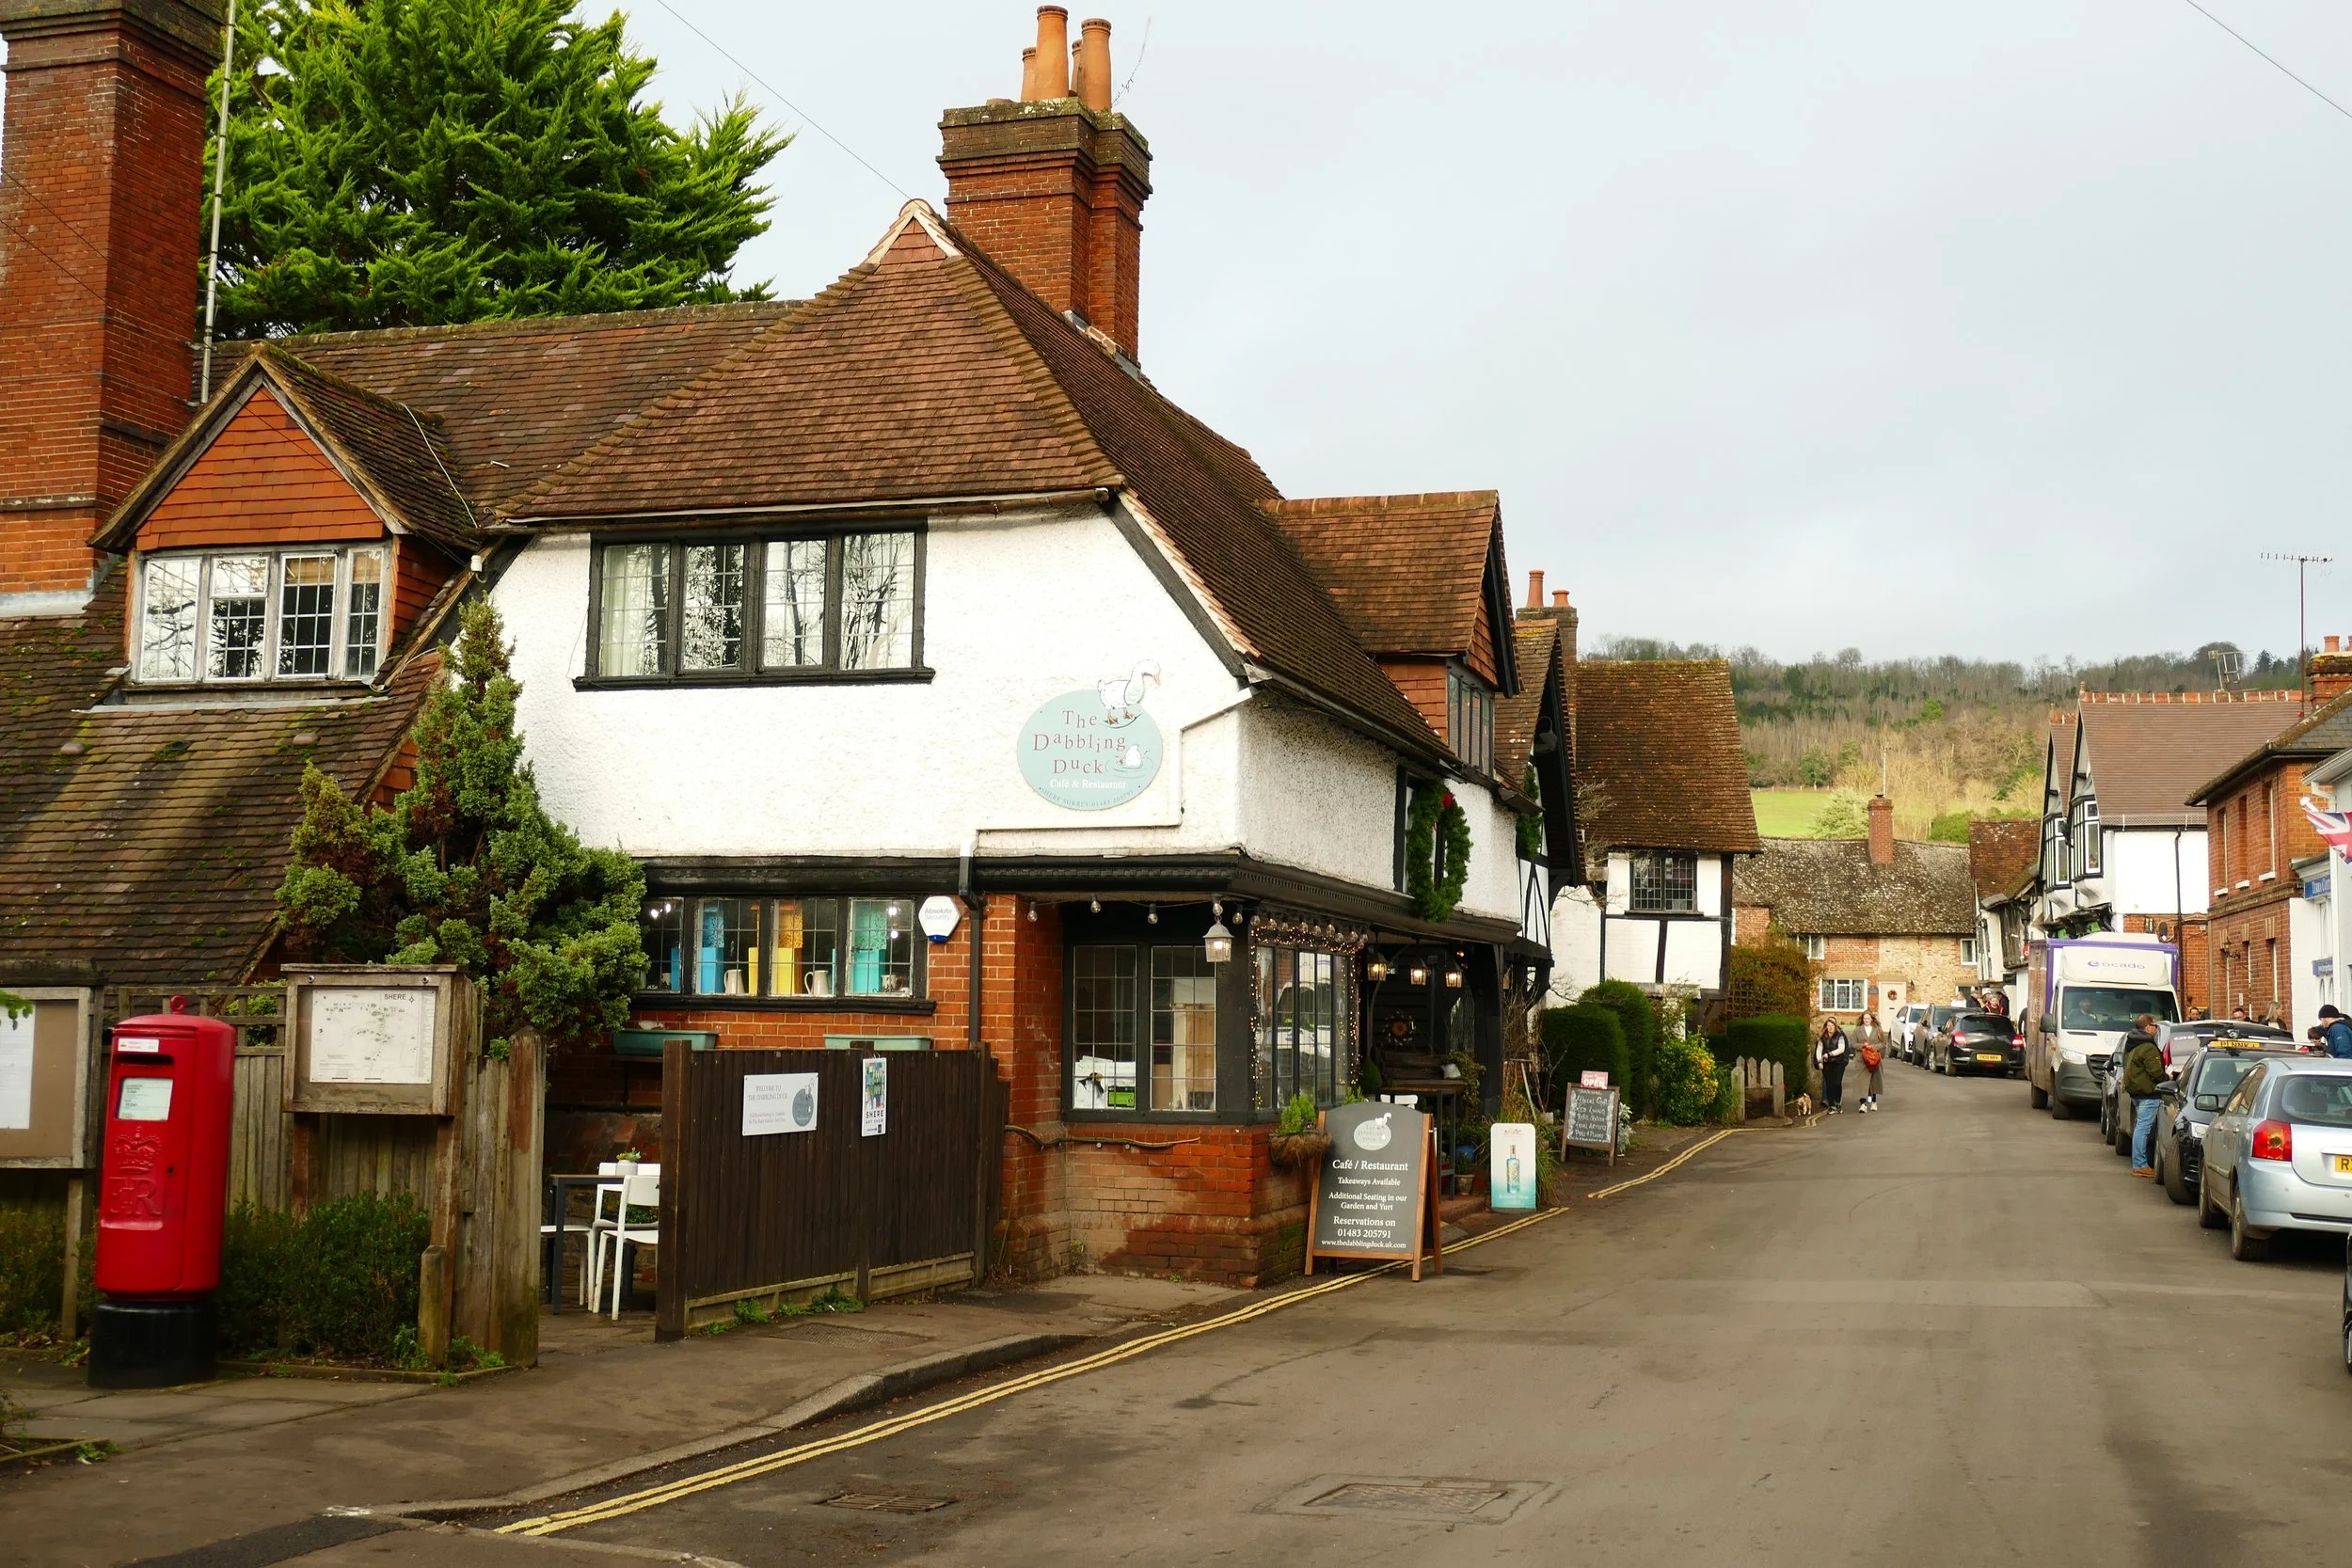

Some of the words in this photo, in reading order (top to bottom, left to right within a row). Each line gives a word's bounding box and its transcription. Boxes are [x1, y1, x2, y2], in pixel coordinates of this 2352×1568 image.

[1062, 710, 1097, 729] The
[1032, 733, 1126, 752] Dabbling
[1054, 758, 1104, 774] Duck
[1049, 778, 1070, 789] Café
[1072, 779, 1080, 789] &
[1082, 779, 1126, 789] Restaurant
[2102, 961, 2145, 970] ocado
[1582, 1078, 1605, 1087] OPEN
[866, 1110, 883, 1119] SHERE
[1332, 1159, 1353, 1170] Café
[1354, 1160, 1359, 1170] /
[1360, 1161, 1408, 1171] Restaurant
[1337, 1177, 1371, 1186] Takeaways
[1372, 1178, 1401, 1186] Available
[1328, 1192, 1362, 1200] Additional
[1363, 1193, 1387, 1202] Seating
[1341, 1201, 1364, 1210] Garden
[1365, 1202, 1377, 1211] and
[1333, 1215, 1384, 1227] Reservations
[1337, 1228, 1361, 1238] 01483
[1363, 1228, 1391, 1239] 205791
[1321, 1239, 1406, 1249] www.thedabblingduck.uk.com
